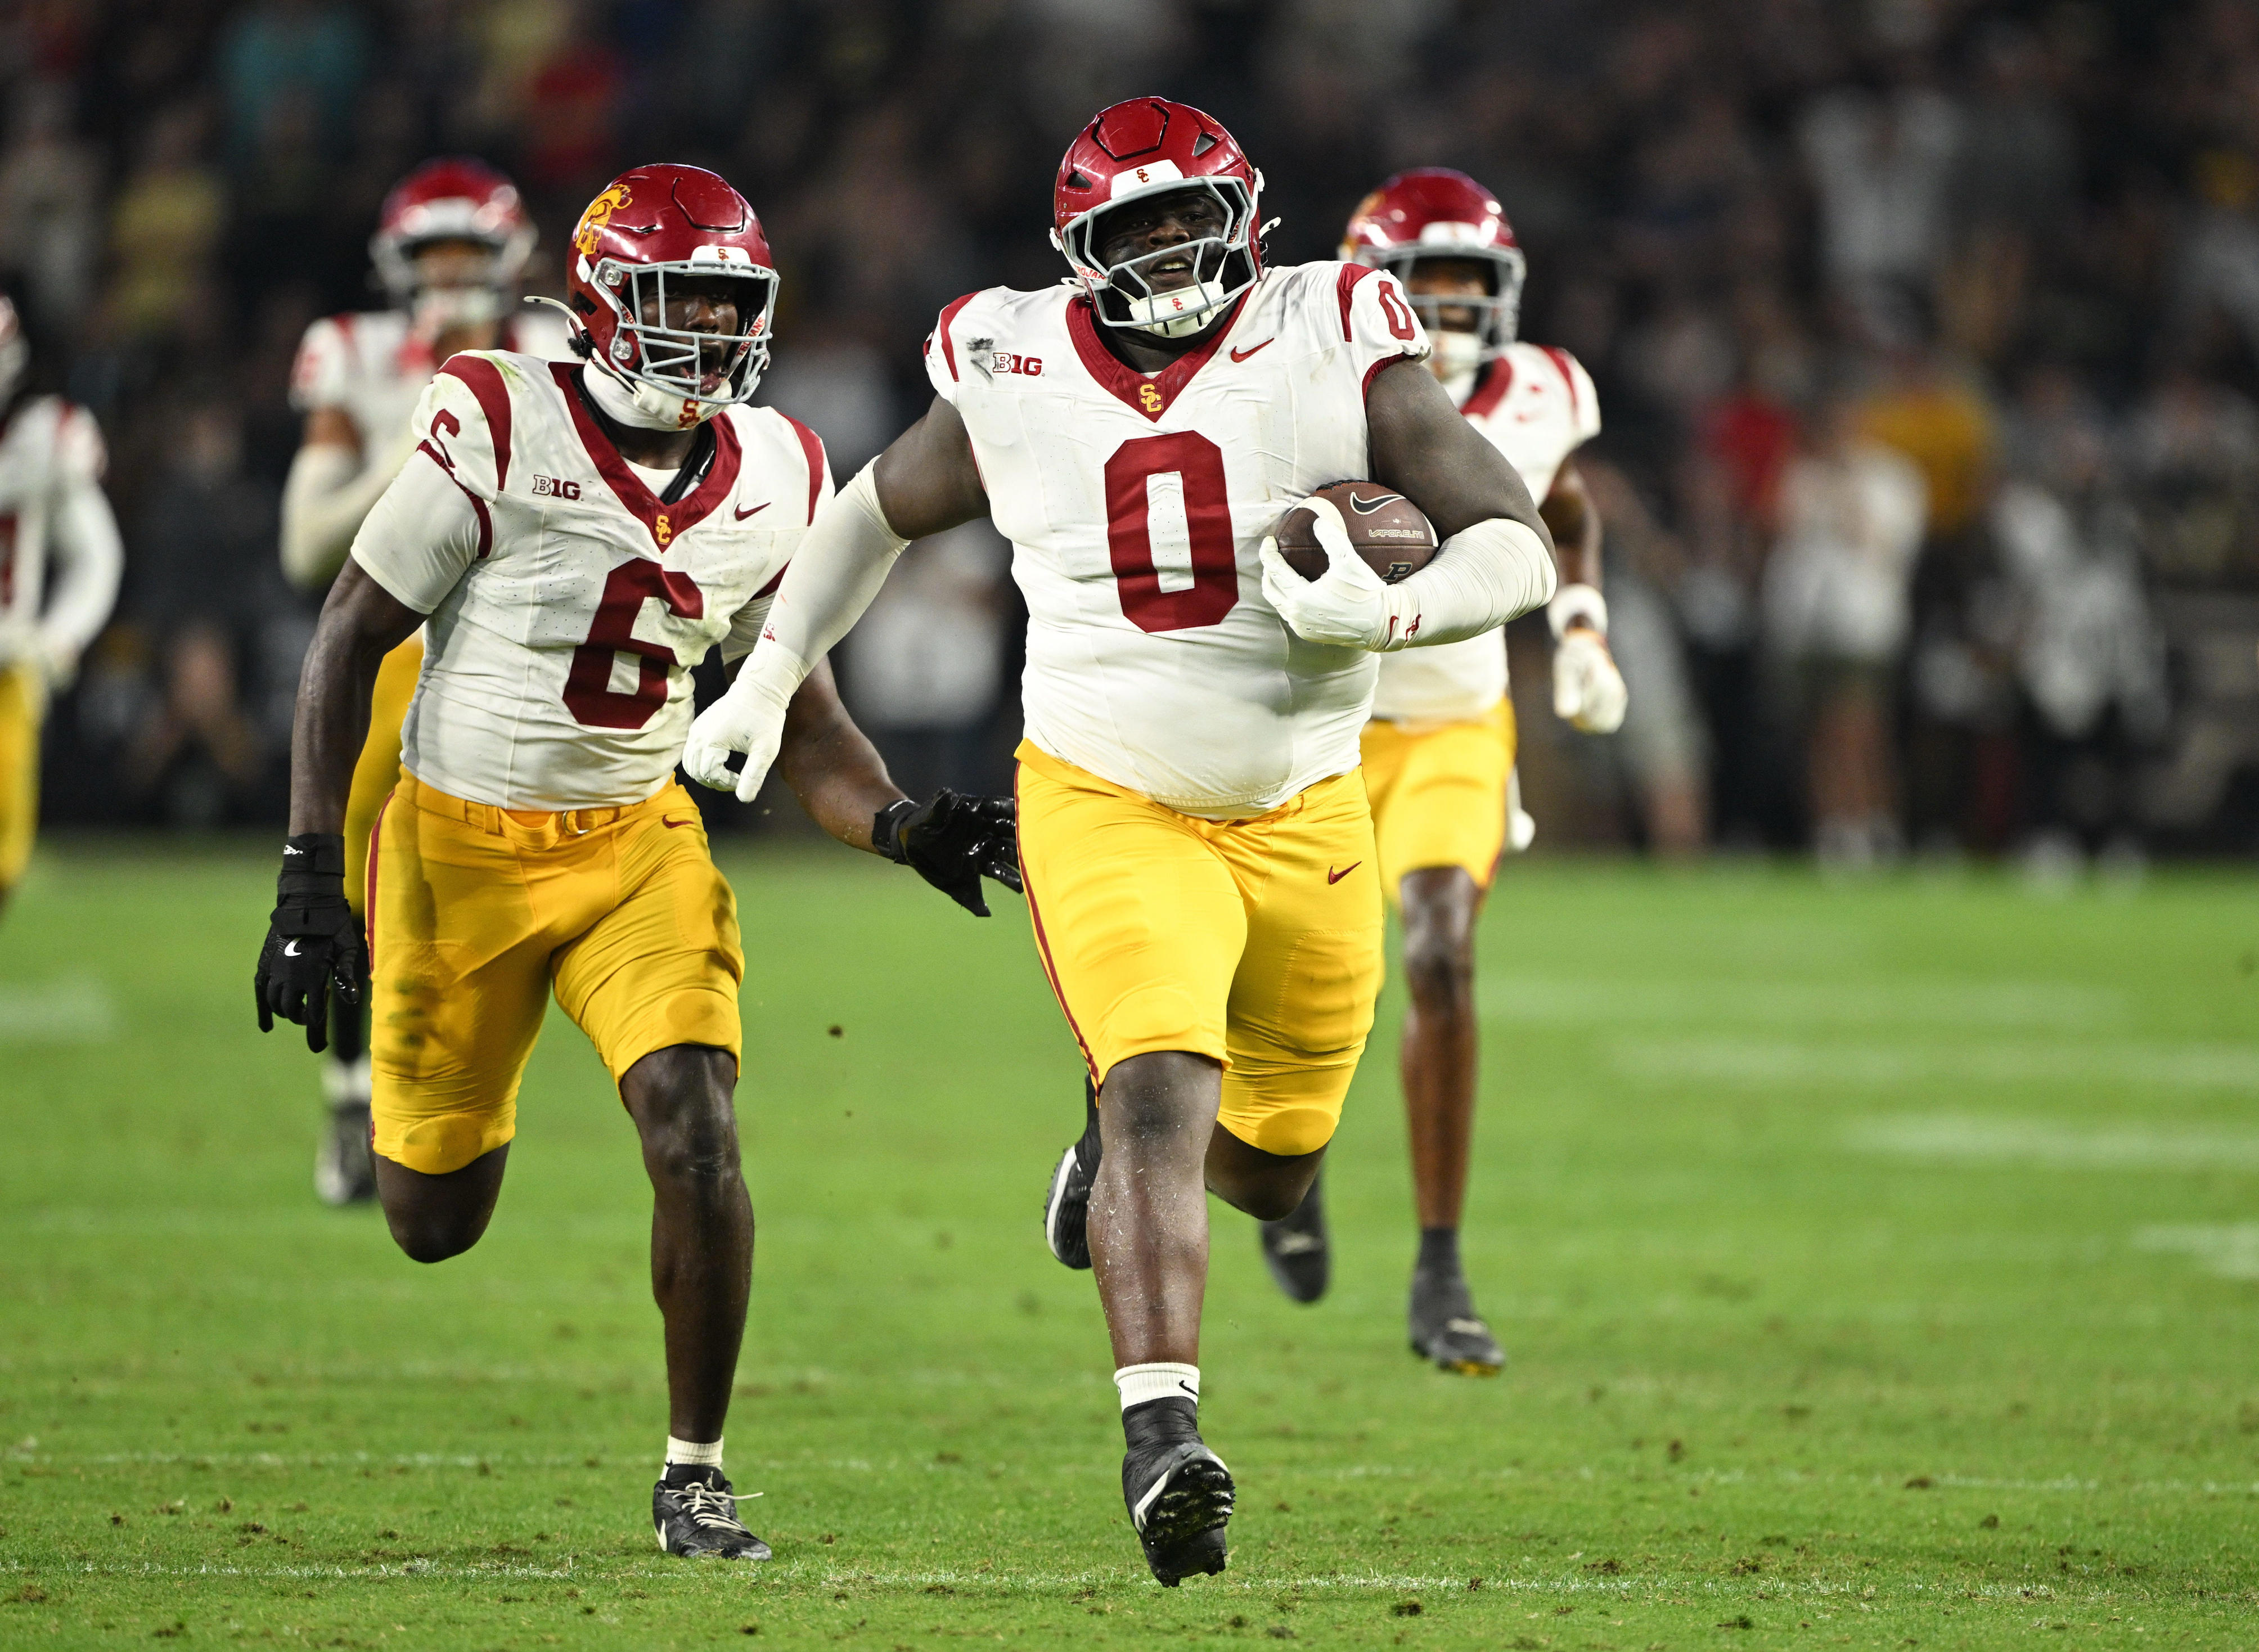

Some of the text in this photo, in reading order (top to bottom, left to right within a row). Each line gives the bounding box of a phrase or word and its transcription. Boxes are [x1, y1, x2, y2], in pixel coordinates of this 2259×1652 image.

[1074, 264, 1106, 280] TROJAN
[1378, 281, 1415, 341] 0
[1105, 430, 1239, 633] 0
[562, 557, 703, 730] 6
